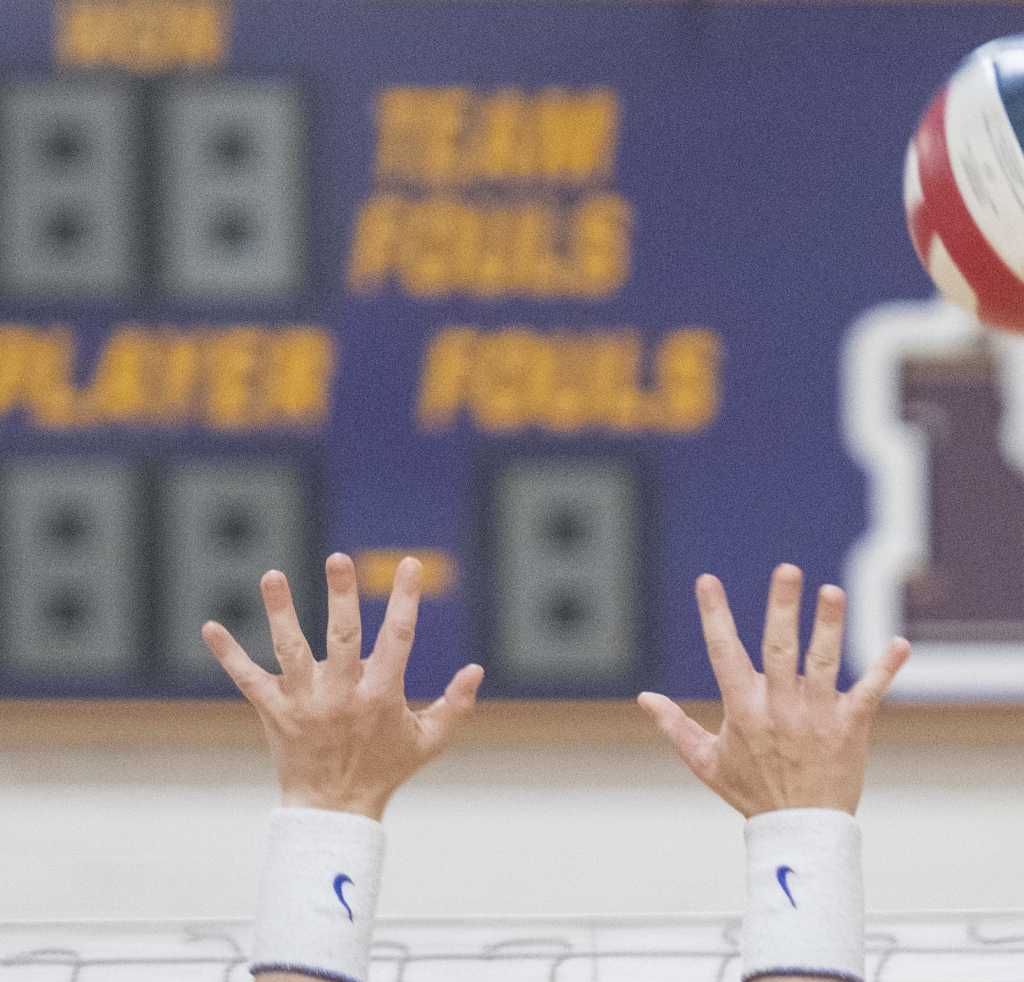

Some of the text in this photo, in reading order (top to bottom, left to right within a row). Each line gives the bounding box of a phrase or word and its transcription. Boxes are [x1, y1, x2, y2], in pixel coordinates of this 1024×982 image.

[375, 88, 621, 180] TEAM
[348, 194, 633, 297] FOULS
[0, 325, 724, 434] PLAYER FOULS
